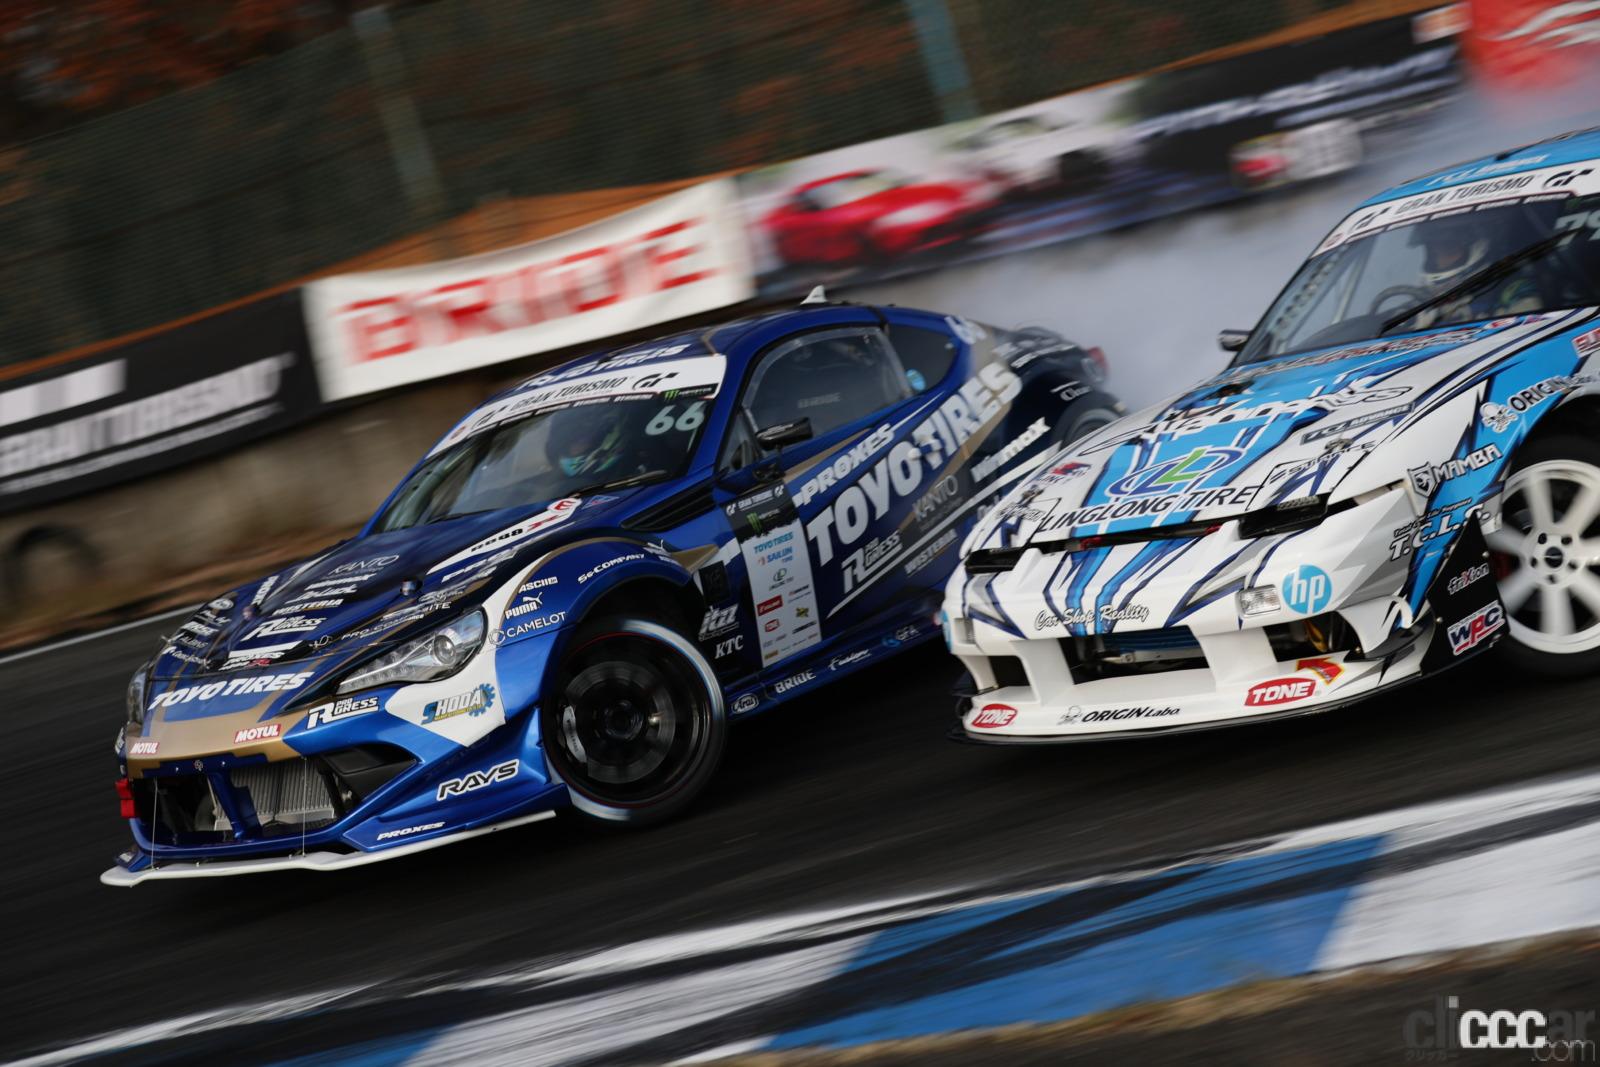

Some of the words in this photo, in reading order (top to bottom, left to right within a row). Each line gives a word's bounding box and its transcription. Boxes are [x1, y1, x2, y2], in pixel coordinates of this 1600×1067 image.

[1396, 192, 1443, 215] GRAN
[1449, 175, 1537, 200] TURISMO
[510, 390, 555, 412] GRAN
[555, 376, 630, 398] TURISMO
[644, 400, 706, 436] 66
[801, 423, 895, 506] PROXES
[1434, 444, 1502, 484] MAMBA
[913, 475, 959, 522] KANTO
[1037, 496, 1176, 534] LINGLONG
[1175, 484, 1264, 512] TIRE
[1291, 568, 1325, 614] hp
[505, 601, 537, 620] PUMA
[506, 611, 566, 638] CAMELOT
[1034, 609, 1061, 631] Car
[1062, 606, 1097, 626] Shop
[1098, 602, 1150, 625] Reality
[1450, 606, 1501, 646] WPC
[714, 634, 744, 660] KTC
[421, 689, 481, 725] SHODA
[1252, 681, 1311, 704] TONE
[976, 707, 1017, 726] TONE
[1082, 706, 1149, 724] ORIGIN
[131, 742, 158, 754] MOTUL
[235, 725, 280, 744] MOTUL
[438, 759, 518, 800] RAYS
[376, 821, 446, 841] PROXES
